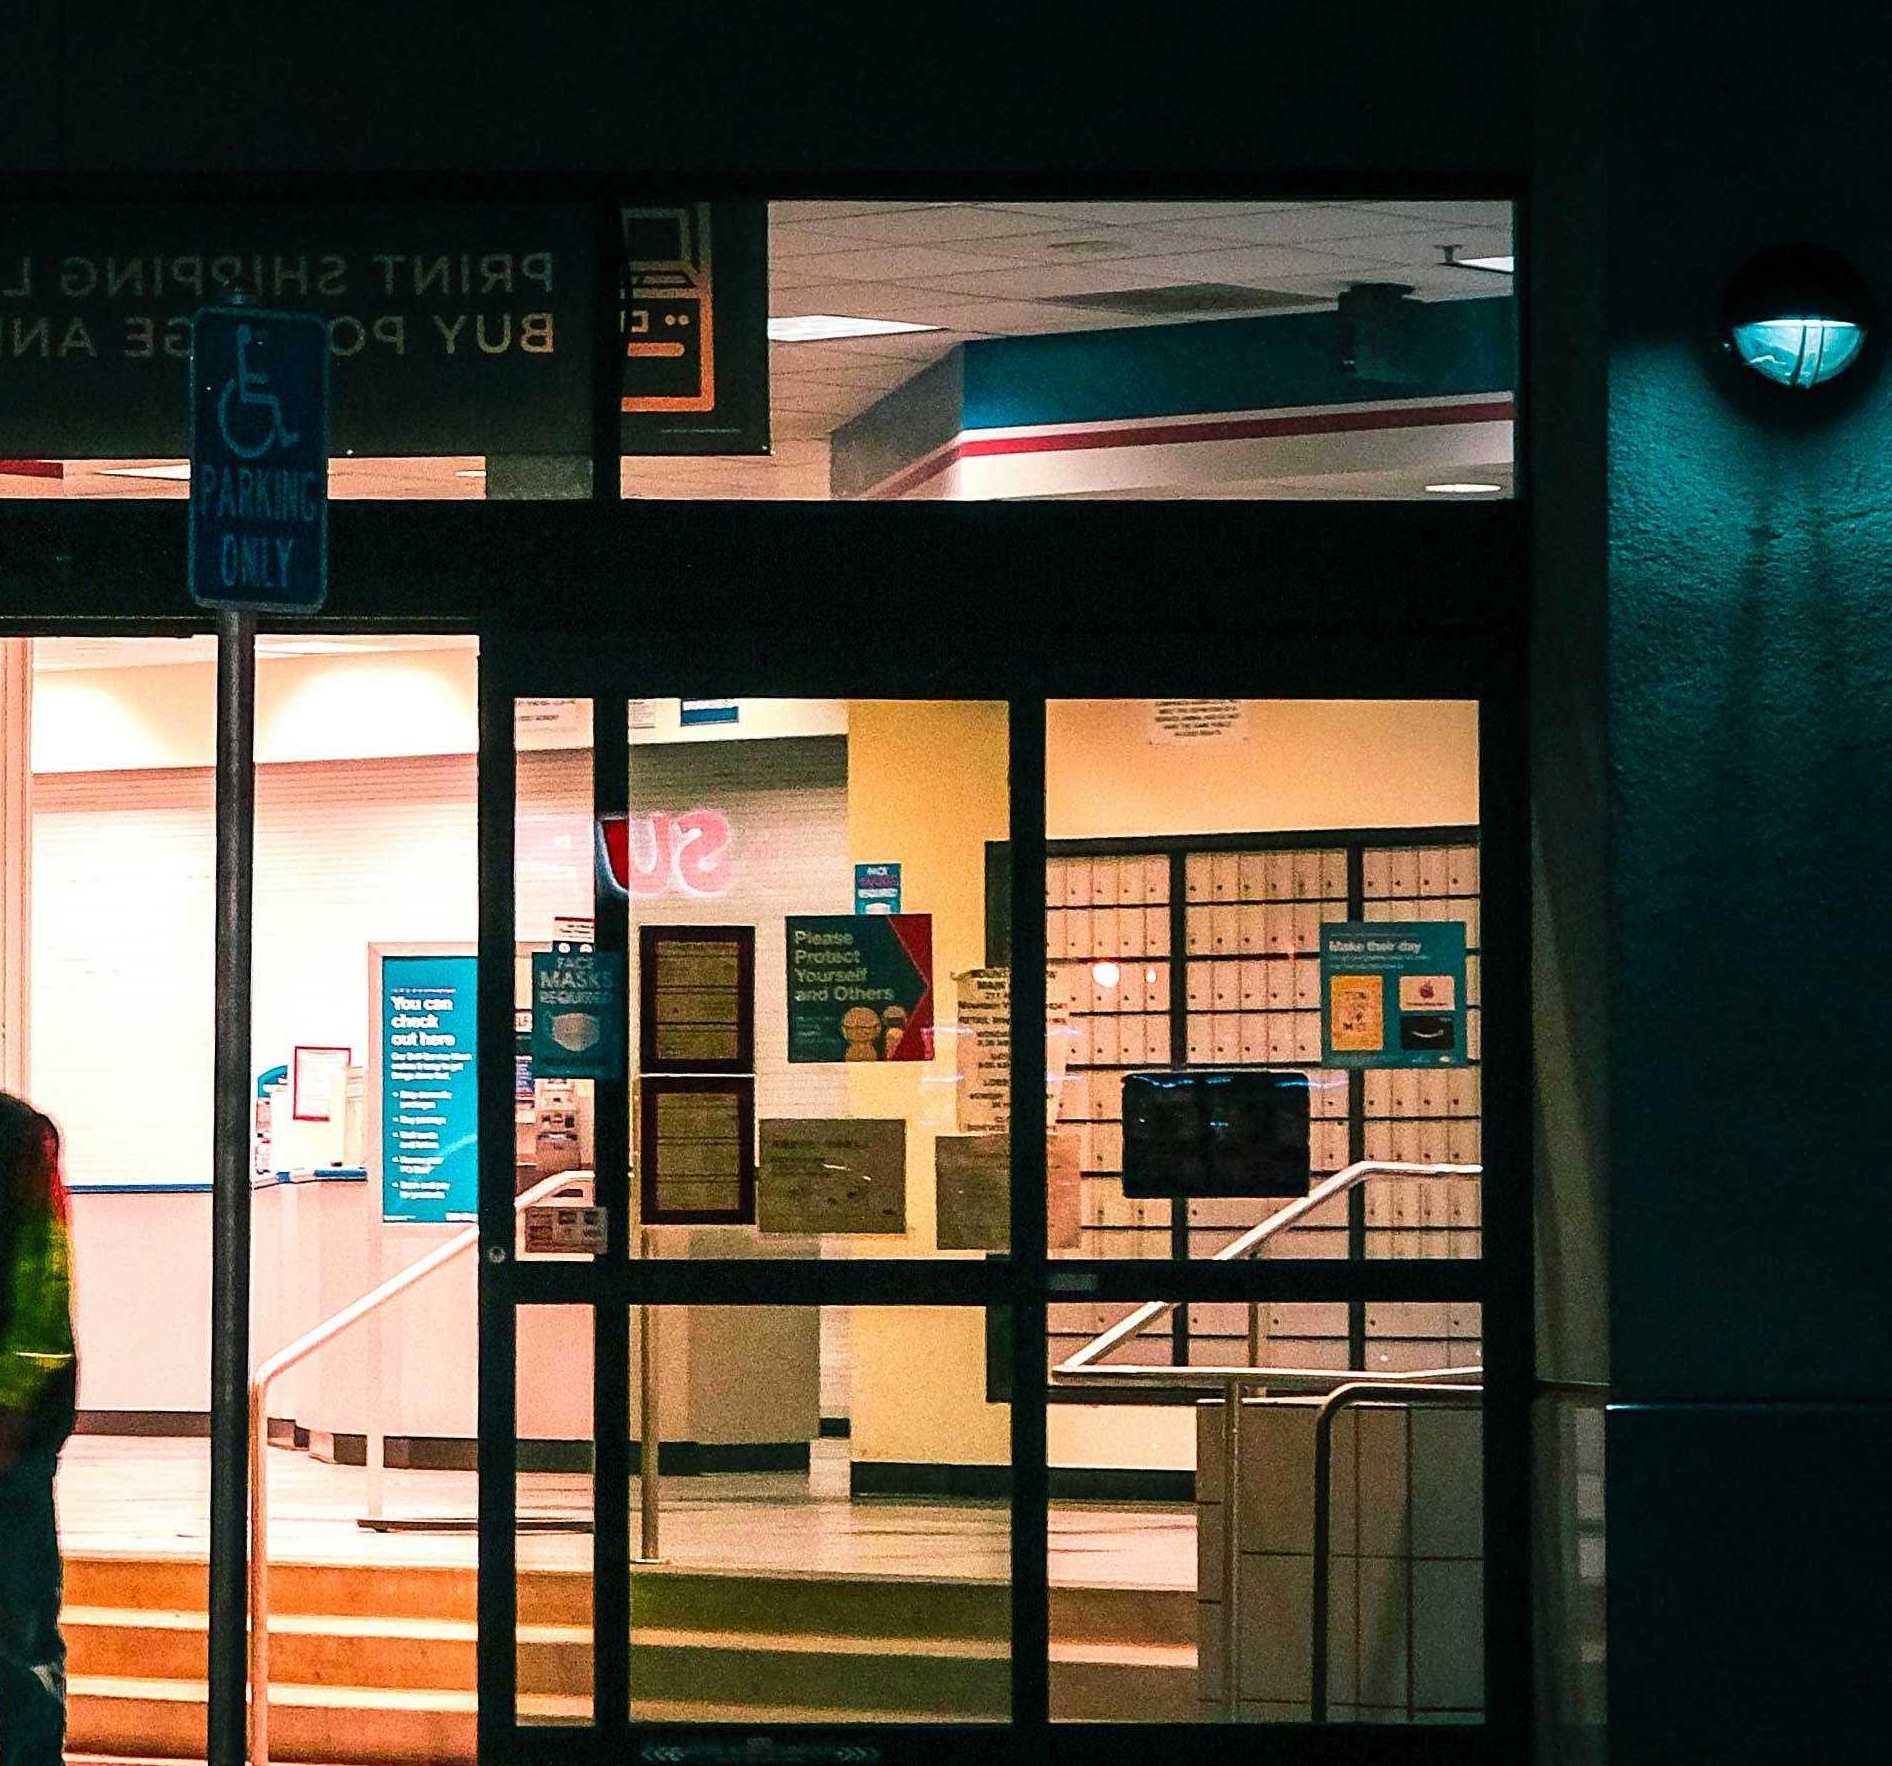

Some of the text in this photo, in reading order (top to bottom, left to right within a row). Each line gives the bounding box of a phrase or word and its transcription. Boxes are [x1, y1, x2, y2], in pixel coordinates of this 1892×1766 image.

[202, 463, 318, 522] PARKING
[220, 533, 296, 589] ONLY
[794, 930, 854, 946] Please
[556, 956, 595, 969] FACE
[794, 949, 861, 965] Protect
[539, 969, 614, 990] MASKS
[795, 967, 868, 983] Yourself
[794, 986, 895, 1002] and Others
[391, 995, 454, 1011] You can
[390, 1014, 439, 1029] check
[390, 1031, 456, 1046] out here
